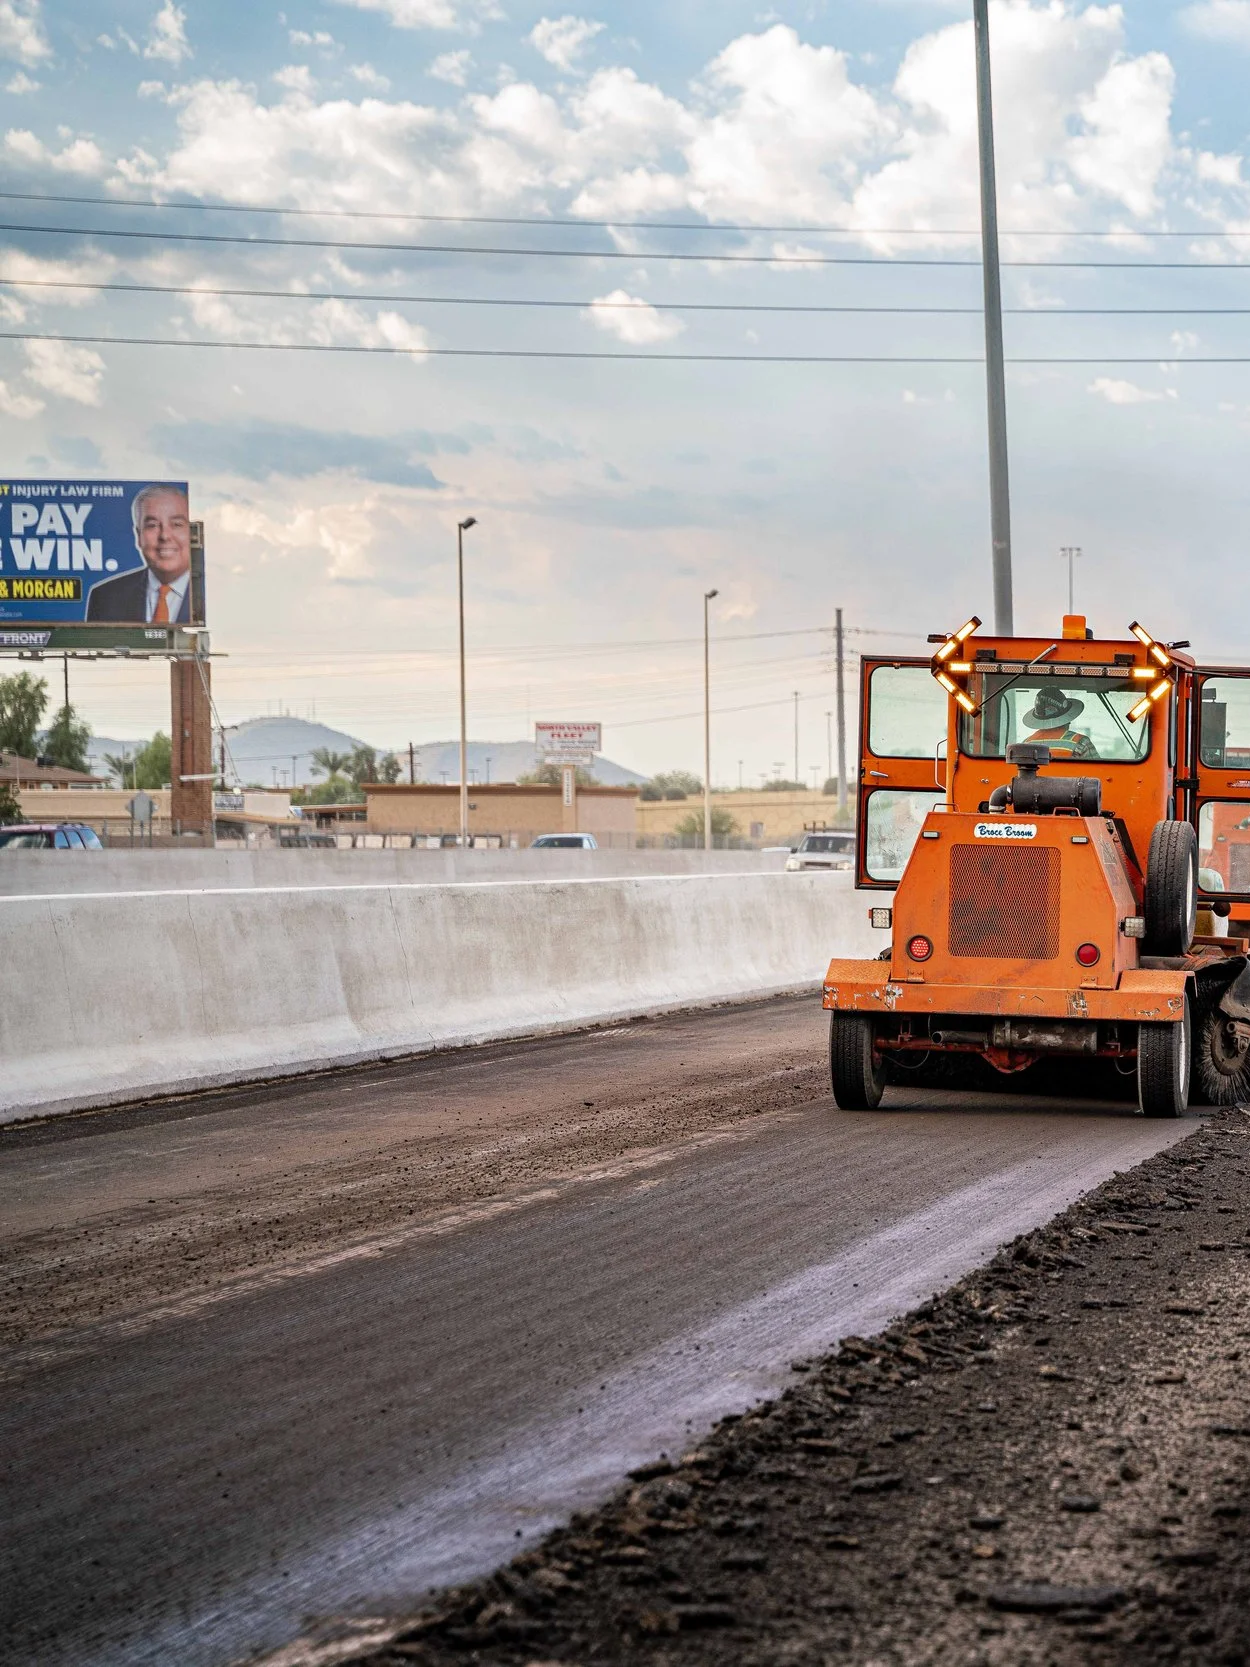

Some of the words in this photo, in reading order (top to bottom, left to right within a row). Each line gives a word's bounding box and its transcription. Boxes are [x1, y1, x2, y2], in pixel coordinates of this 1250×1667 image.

[12, 485, 57, 499] INJURY
[60, 485, 89, 497] LAW
[92, 486, 124, 497] FIRM
[11, 503, 93, 536] PAY
[9, 537, 118, 572] WIN.
[12, 579, 74, 599] MORGAN
[978, 825, 1003, 836] Broce
[1004, 826, 1033, 837] Broom
